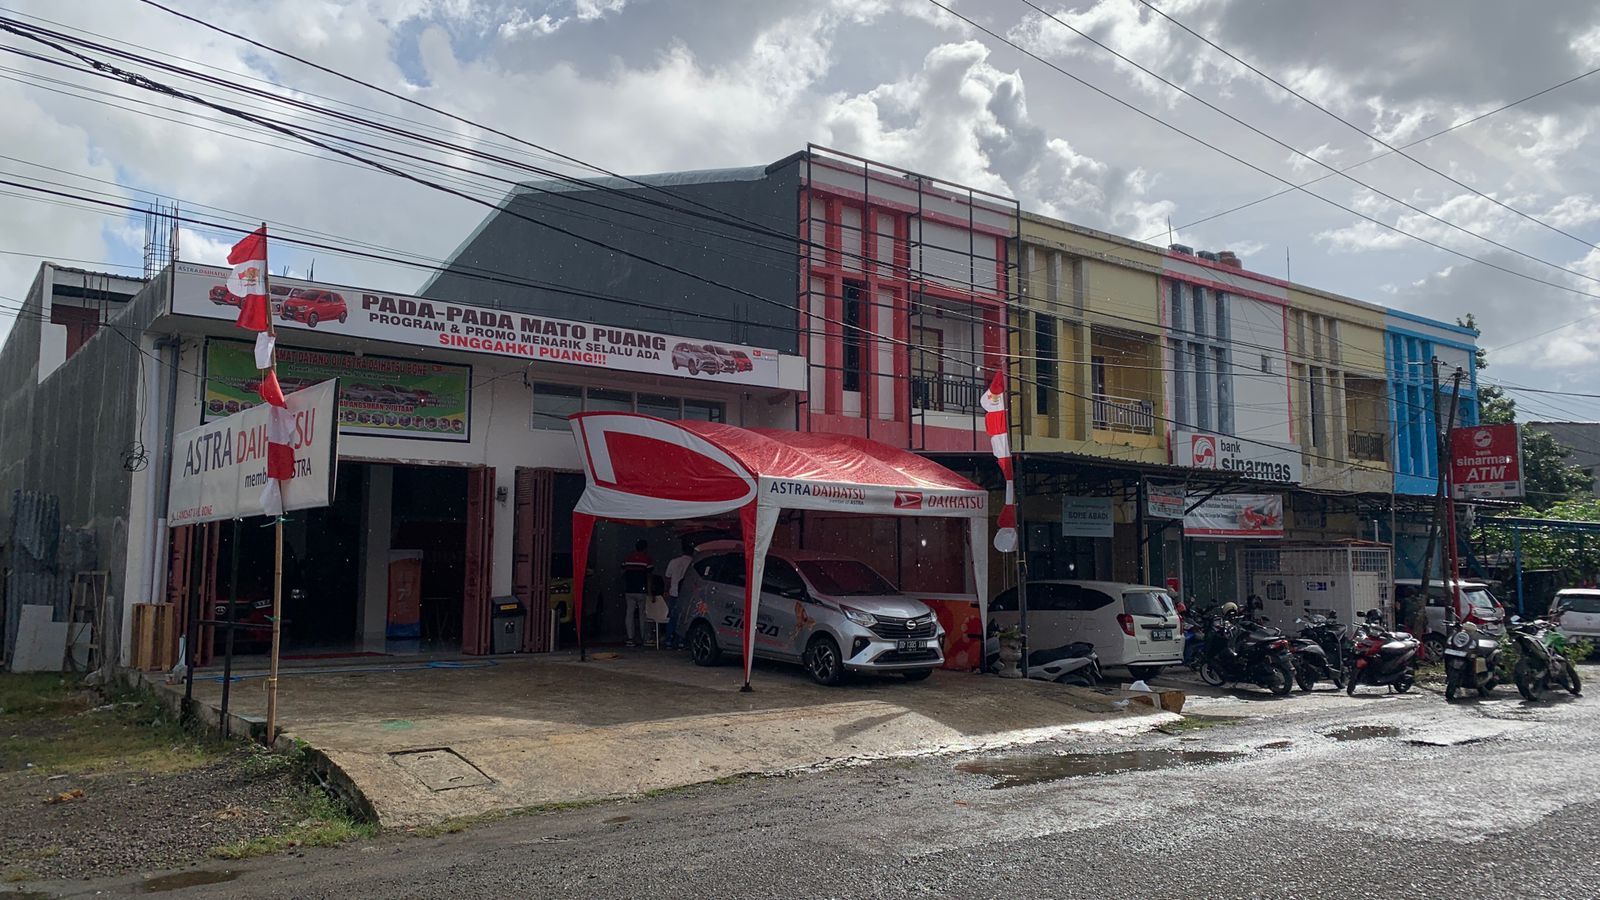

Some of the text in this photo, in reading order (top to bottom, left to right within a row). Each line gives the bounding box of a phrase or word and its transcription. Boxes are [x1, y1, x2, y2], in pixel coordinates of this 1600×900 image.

[362, 293, 666, 351] PADA-PADA MATO PUANG
[369, 312, 660, 361] PROGRAM & PROMO MENARIK SELALU ADA
[439, 333, 606, 365] SINGGAHKI PUANG!!!
[183, 427, 233, 478] ASTRA
[1220, 439, 1240, 453] bank
[291, 457, 312, 479] STRA
[1222, 453, 1291, 482] sinarmas
[1456, 455, 1513, 467] sinarmas
[1466, 466, 1506, 482] ATM
[770, 481, 866, 500] ASTRA DAIHATSU
[928, 495, 984, 509] DAIHATSU
